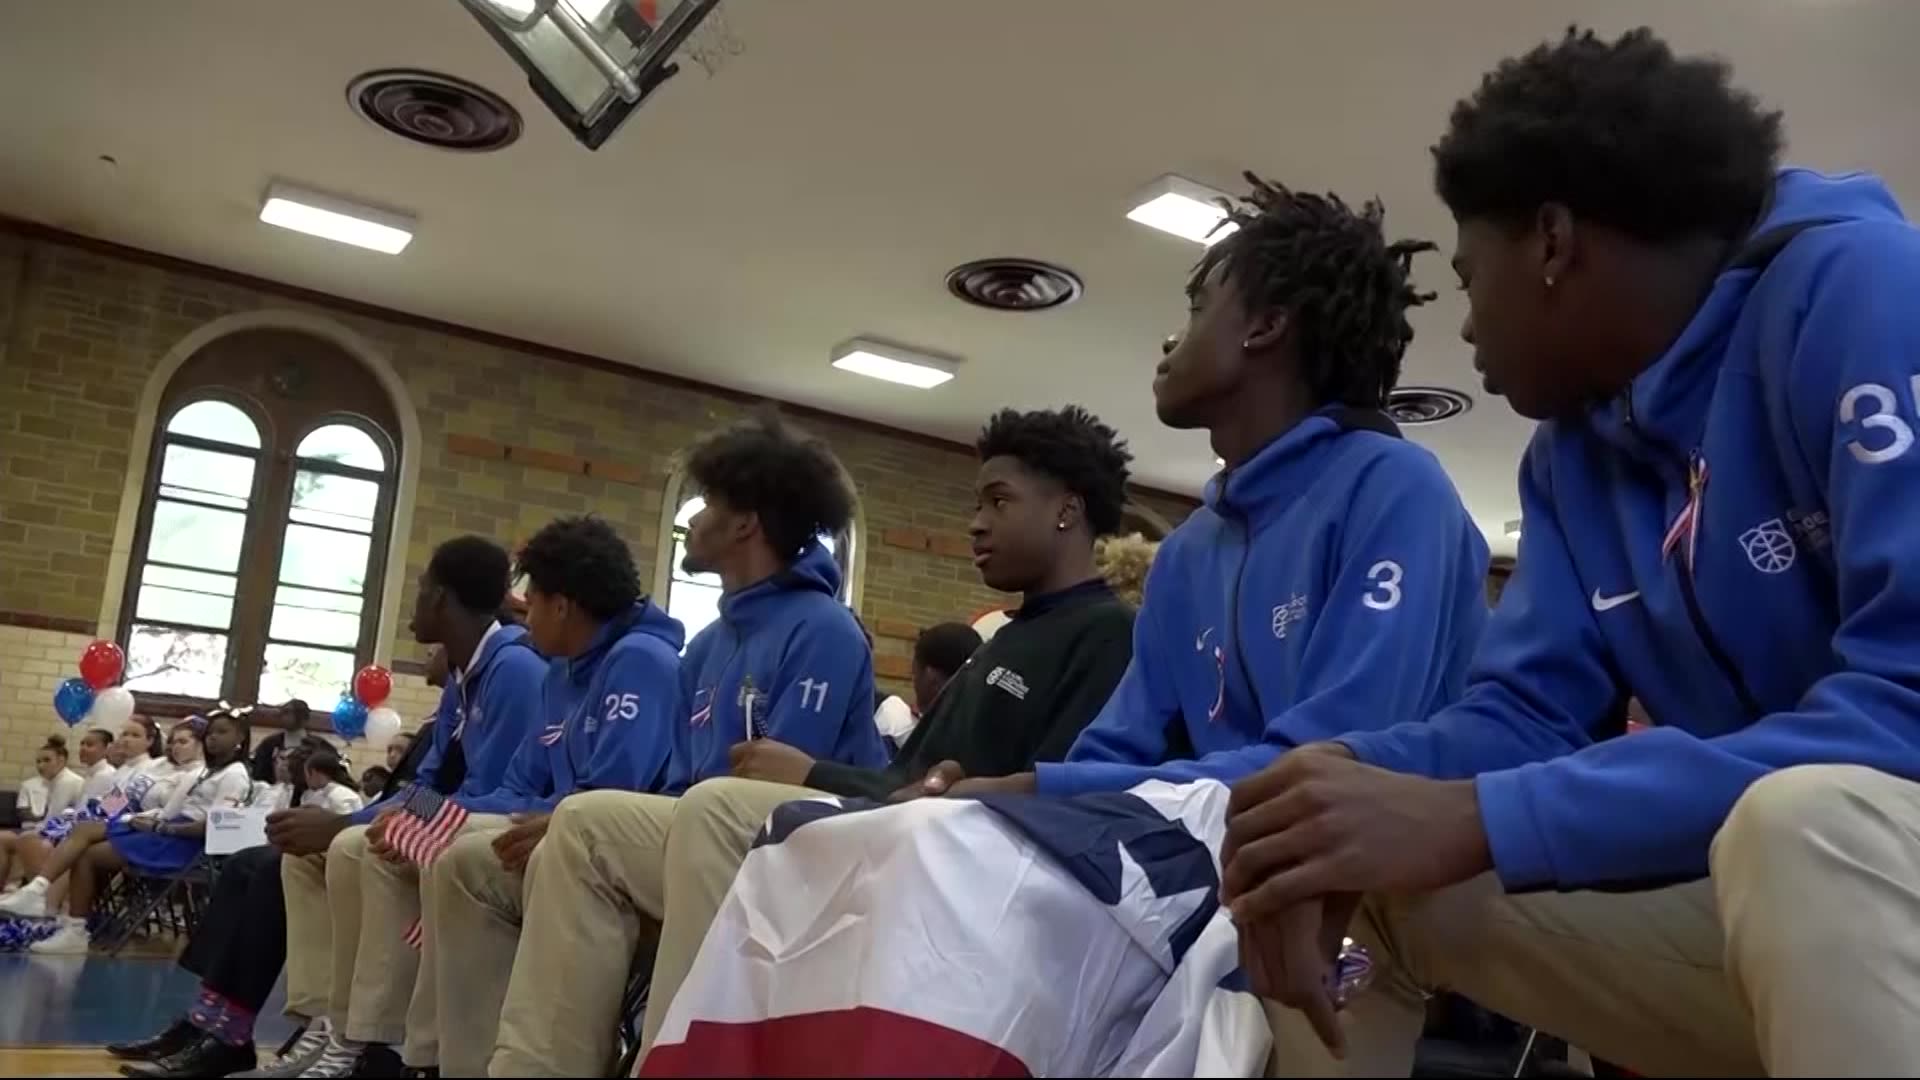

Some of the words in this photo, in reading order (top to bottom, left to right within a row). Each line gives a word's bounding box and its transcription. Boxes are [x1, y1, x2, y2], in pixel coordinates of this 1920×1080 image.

[1840, 374, 1920, 464] 3
[1363, 560, 1404, 611] 3
[605, 693, 640, 720] 25
[799, 678, 829, 712] 11
